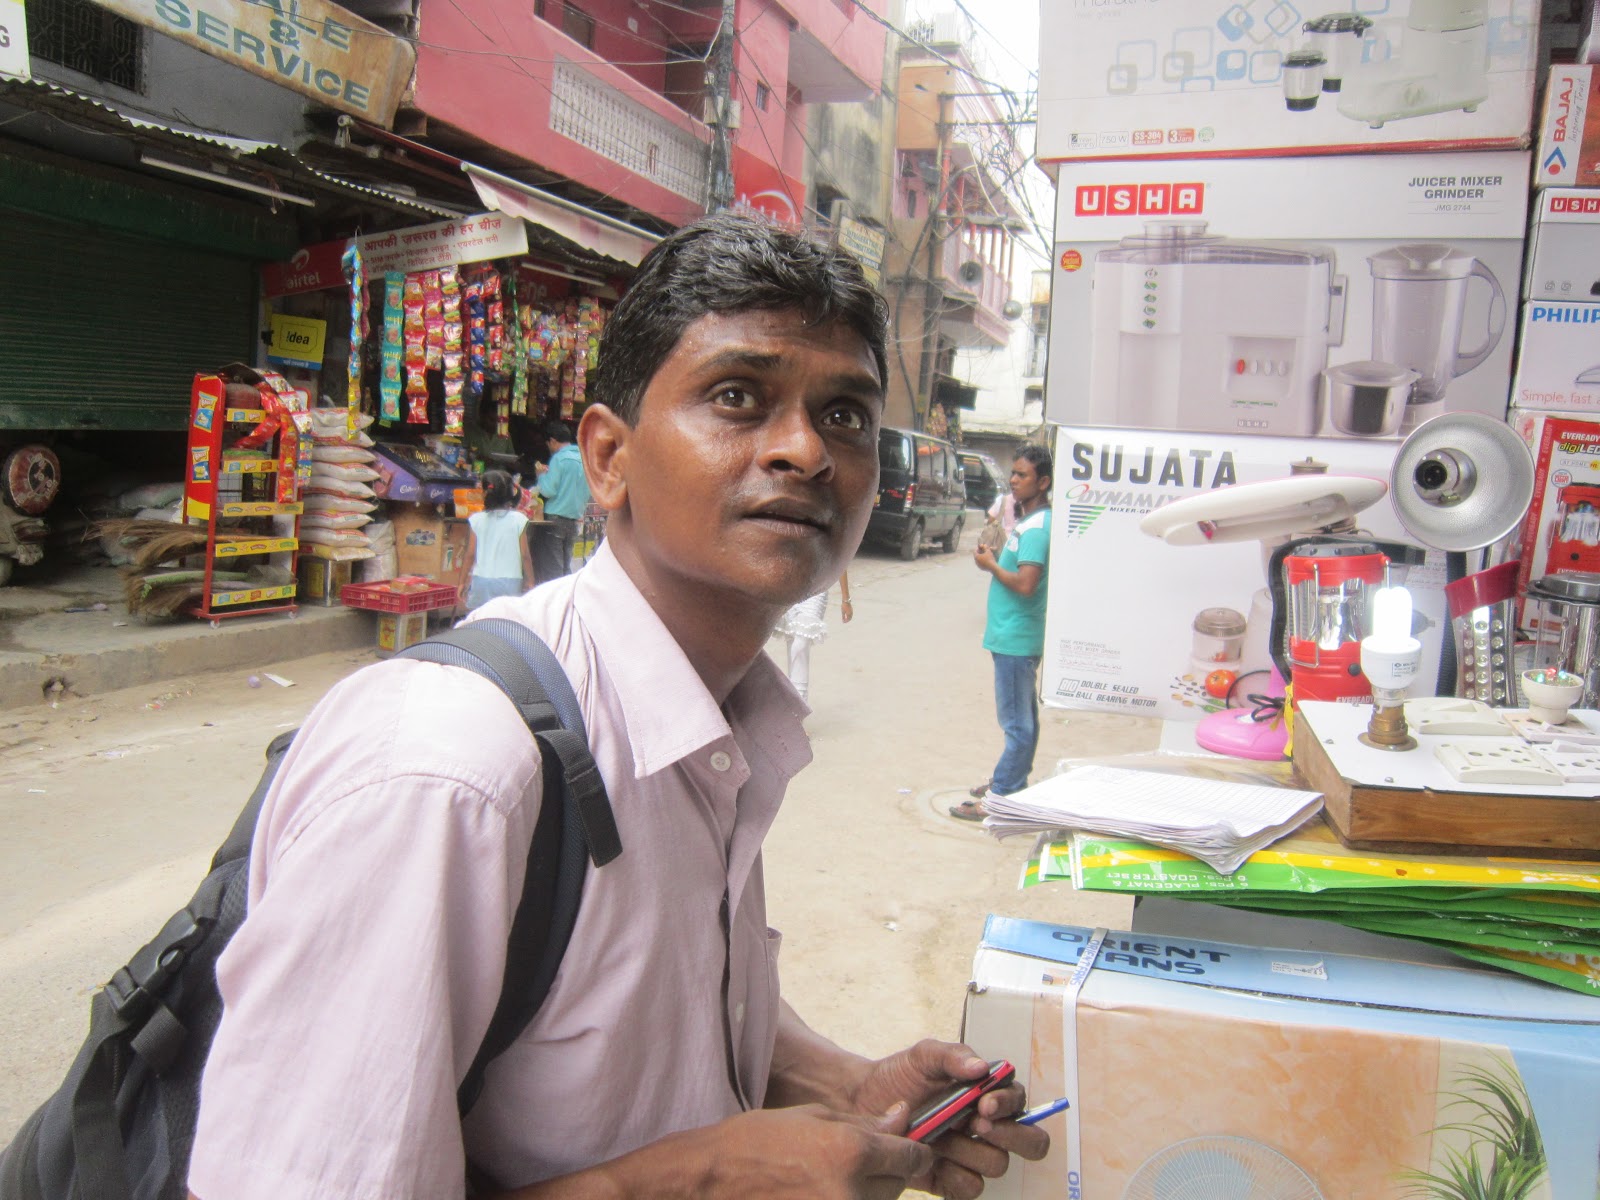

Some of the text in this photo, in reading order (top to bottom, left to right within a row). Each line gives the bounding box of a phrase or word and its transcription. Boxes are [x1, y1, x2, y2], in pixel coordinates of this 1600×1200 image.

[154, 0, 371, 110] SERVICE
[1553, 77, 1574, 142] BAJAJ
[1569, 78, 1586, 142] Inspiring Trust
[1134, 131, 1161, 141] SS-304
[1169, 130, 1178, 143] 3
[1408, 176, 1503, 188] JUICER MIXER
[1078, 186, 1200, 215] USHA
[1424, 188, 1485, 200] GRINDER
[1453, 204, 1472, 212] 2744
[365, 235, 397, 250] आपकी
[441, 224, 455, 237] की
[460, 222, 473, 236] हर
[287, 271, 321, 290] airtel
[1522, 389, 1567, 405] Simple,
[1570, 391, 1592, 404] fast
[1561, 431, 1600, 442] EVEREADY
[1072, 442, 1237, 489] SUJATA
[1081, 680, 1108, 691] DOUBLE
[1112, 684, 1139, 695] SEALED
[1075, 690, 1093, 701] BALL
[1096, 693, 1128, 704] BEARING
[1131, 698, 1158, 708] MOTOR
[1105, 872, 1130, 880] SET
[1131, 873, 1198, 882] COASTER
[1127, 880, 1201, 889] PLACEMAT
